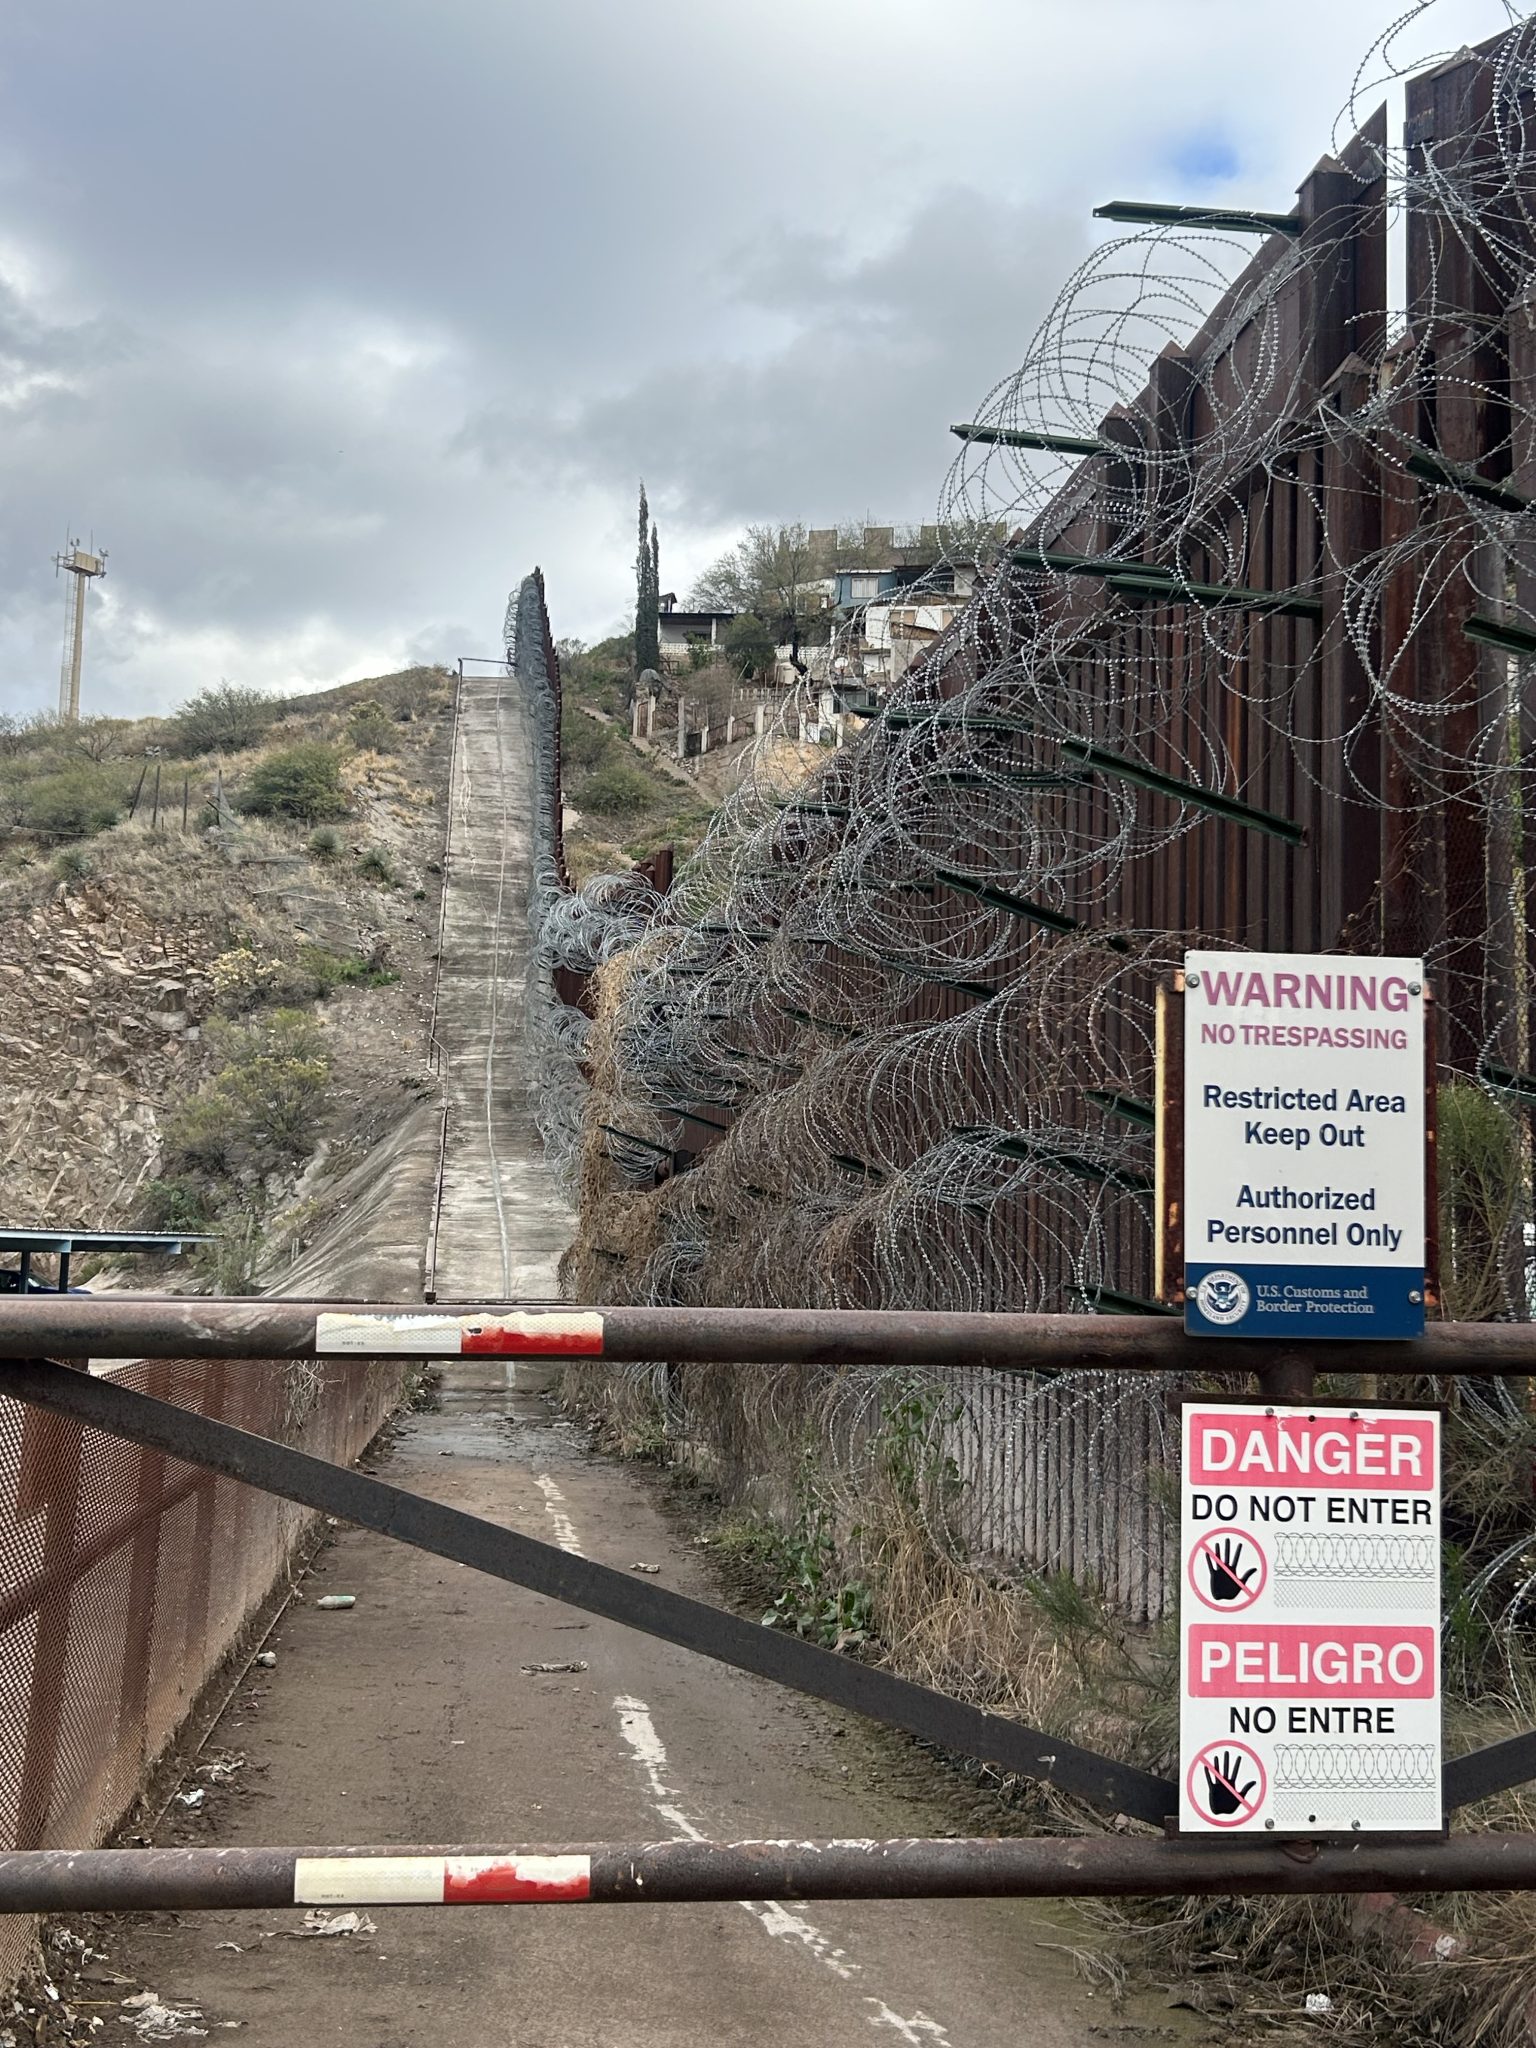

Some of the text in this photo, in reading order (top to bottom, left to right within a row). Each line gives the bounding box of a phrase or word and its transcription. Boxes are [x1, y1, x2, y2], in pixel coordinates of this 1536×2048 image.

[1201, 970, 1408, 1012] WARNING
[1202, 1024, 1407, 1049] NO TRESPASSING
[1203, 1085, 1405, 1113] Restricted Area
[1245, 1122, 1365, 1150] Keep Out
[1236, 1185, 1375, 1211] Authorized
[1207, 1220, 1402, 1251] Personnel Only
[1256, 1285, 1368, 1299] U.S. Customs and
[1256, 1299, 1374, 1314] Border Protection
[1202, 1429, 1422, 1476] DANGER
[1192, 1495, 1431, 1524] DO NOT ENTER
[1201, 1641, 1423, 1684] PELIGRO
[1230, 1706, 1394, 1733] NO ENTRE
